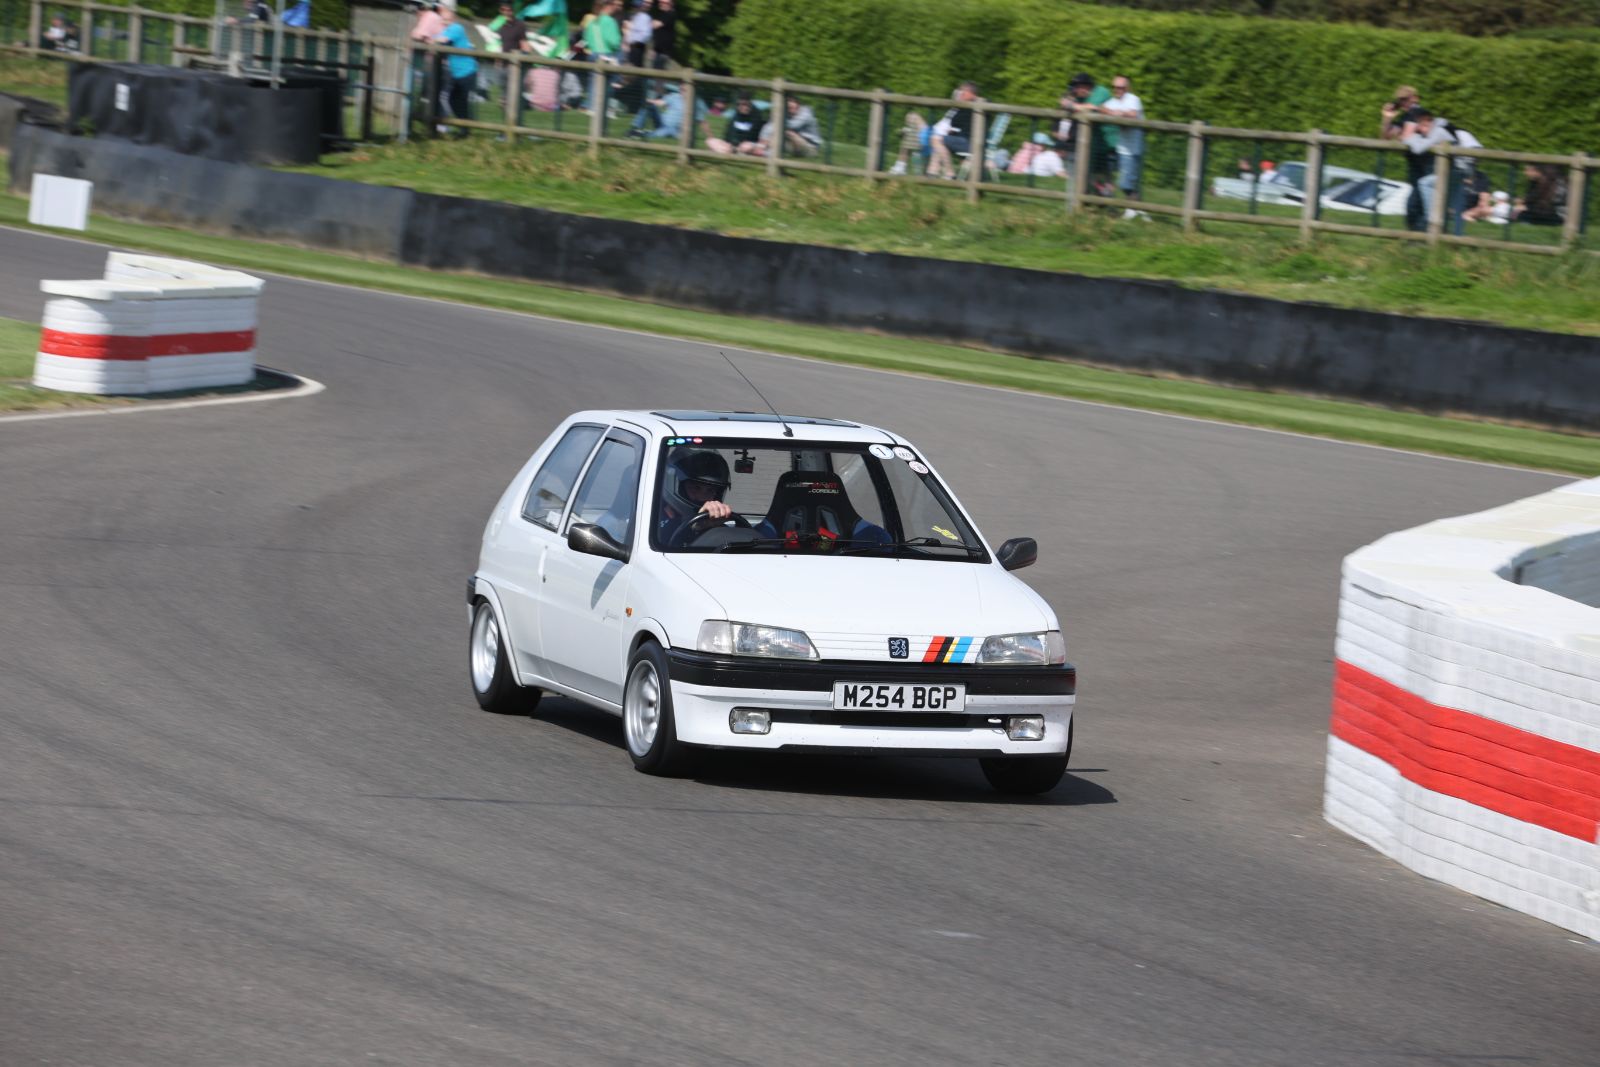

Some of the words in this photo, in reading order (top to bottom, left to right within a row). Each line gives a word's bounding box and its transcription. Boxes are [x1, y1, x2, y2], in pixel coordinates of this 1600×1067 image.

[875, 447, 887, 456] 1
[843, 684, 905, 709] M254
[912, 686, 957, 709] BGP
